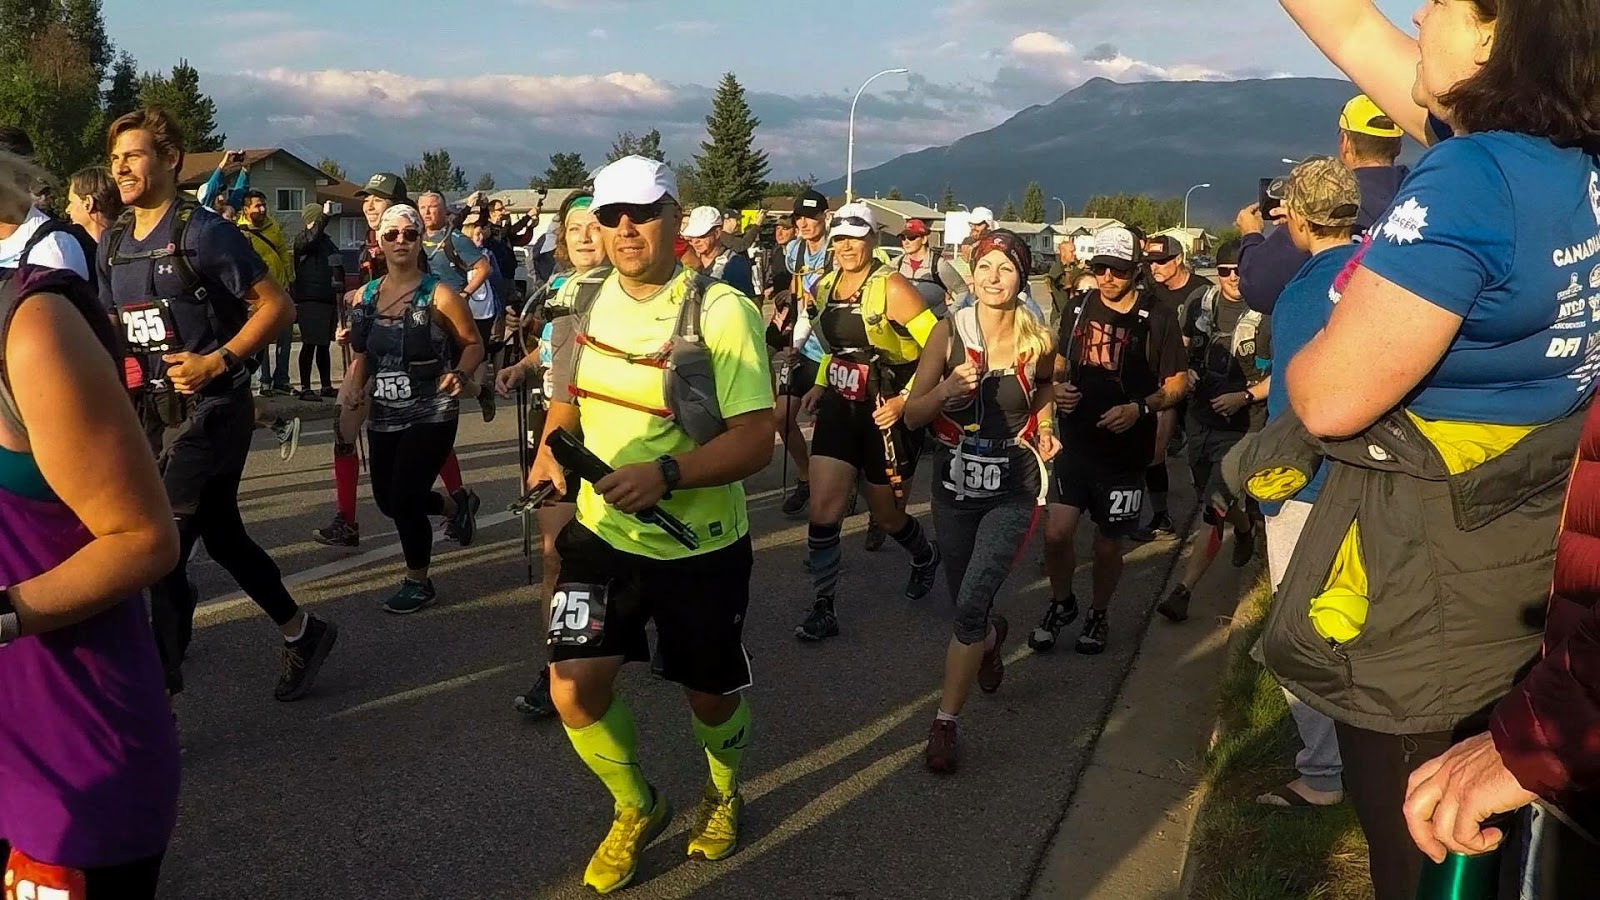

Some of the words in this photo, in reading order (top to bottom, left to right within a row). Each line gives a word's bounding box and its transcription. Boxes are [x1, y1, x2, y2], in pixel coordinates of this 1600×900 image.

[1558, 298, 1586, 318] ATCO
[122, 308, 166, 343] 255
[1544, 337, 1582, 358] DFI
[829, 363, 860, 392] 594
[1109, 489, 1142, 514] 270
[549, 591, 590, 630] 25
